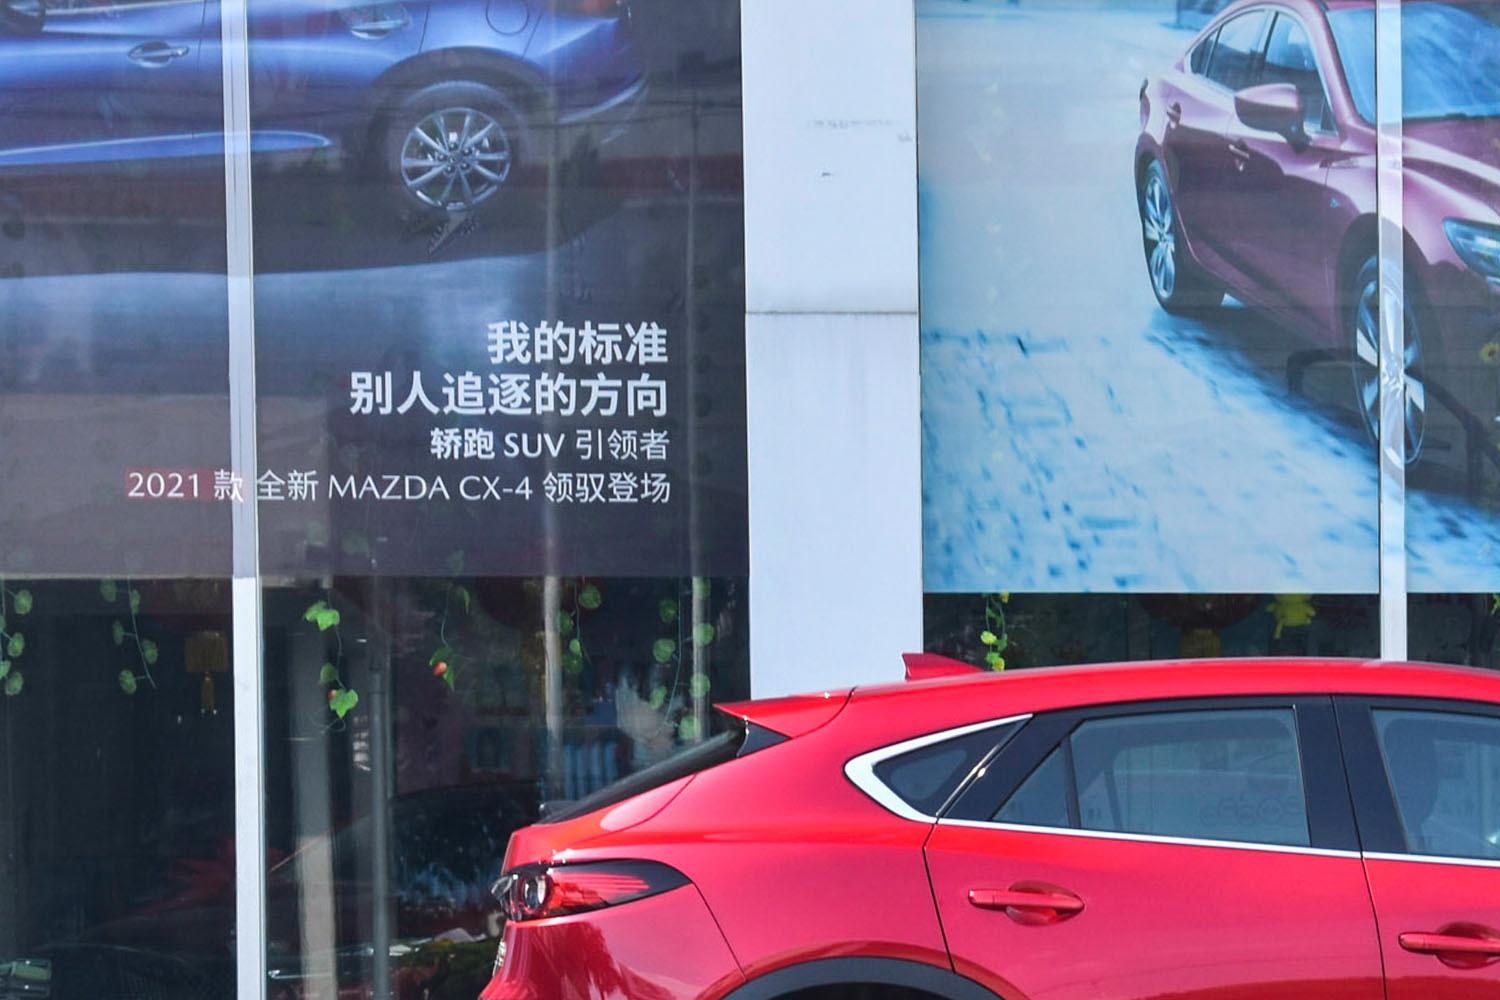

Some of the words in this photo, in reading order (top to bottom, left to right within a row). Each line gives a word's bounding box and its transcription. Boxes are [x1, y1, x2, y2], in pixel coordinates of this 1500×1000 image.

[487, 320, 668, 365] 我的标准
[350, 370, 668, 417] 别人追逐的方向
[430, 427, 495, 459] 轿跑
[504, 433, 565, 458] SUV
[576, 429, 670, 460] 引领者
[128, 472, 199, 498] 2021
[256, 469, 319, 501] 全新
[328, 475, 450, 500] MAZDA
[459, 475, 533, 500] CX-4
[543, 472, 671, 503] 领驭登场
